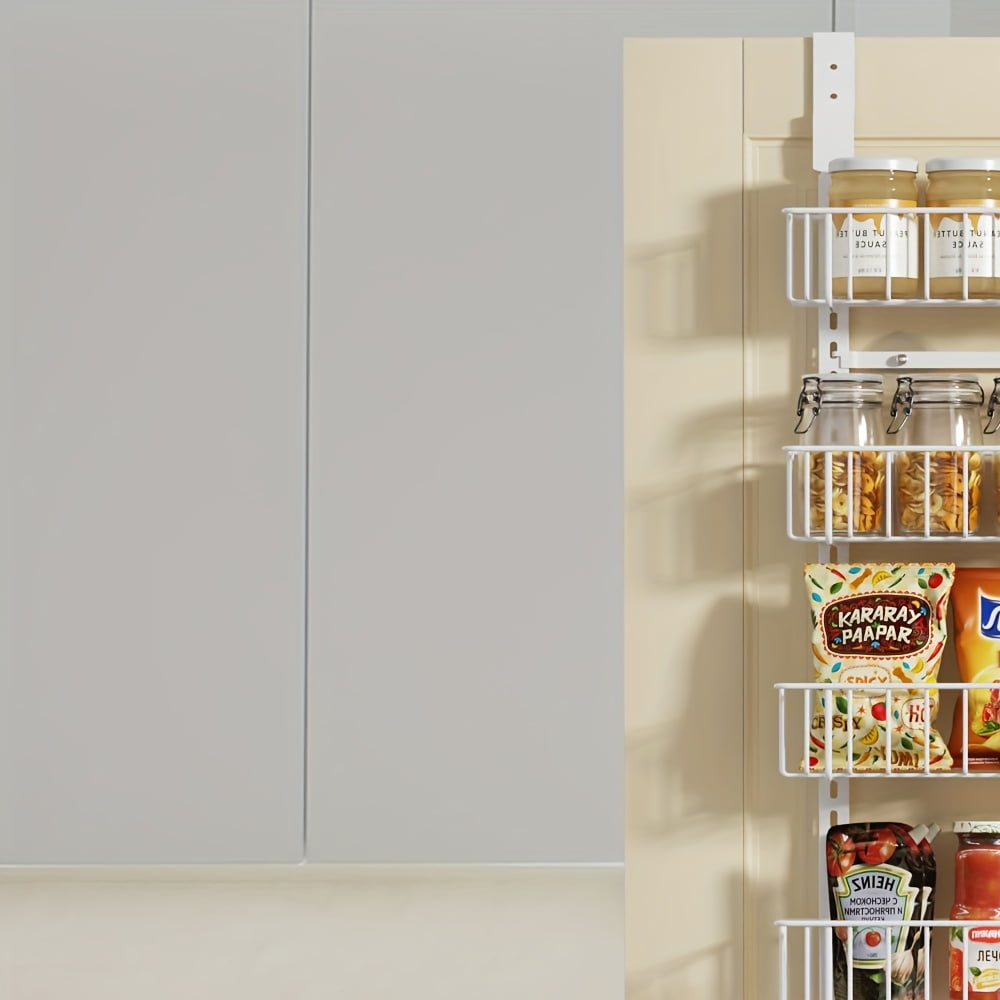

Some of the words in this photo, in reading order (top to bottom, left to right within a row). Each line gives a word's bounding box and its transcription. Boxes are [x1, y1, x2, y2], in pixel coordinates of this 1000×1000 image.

[838, 604, 923, 628] KARARAY
[841, 624, 913, 645] PAAPAR
[811, 714, 862, 731] CRSPY
